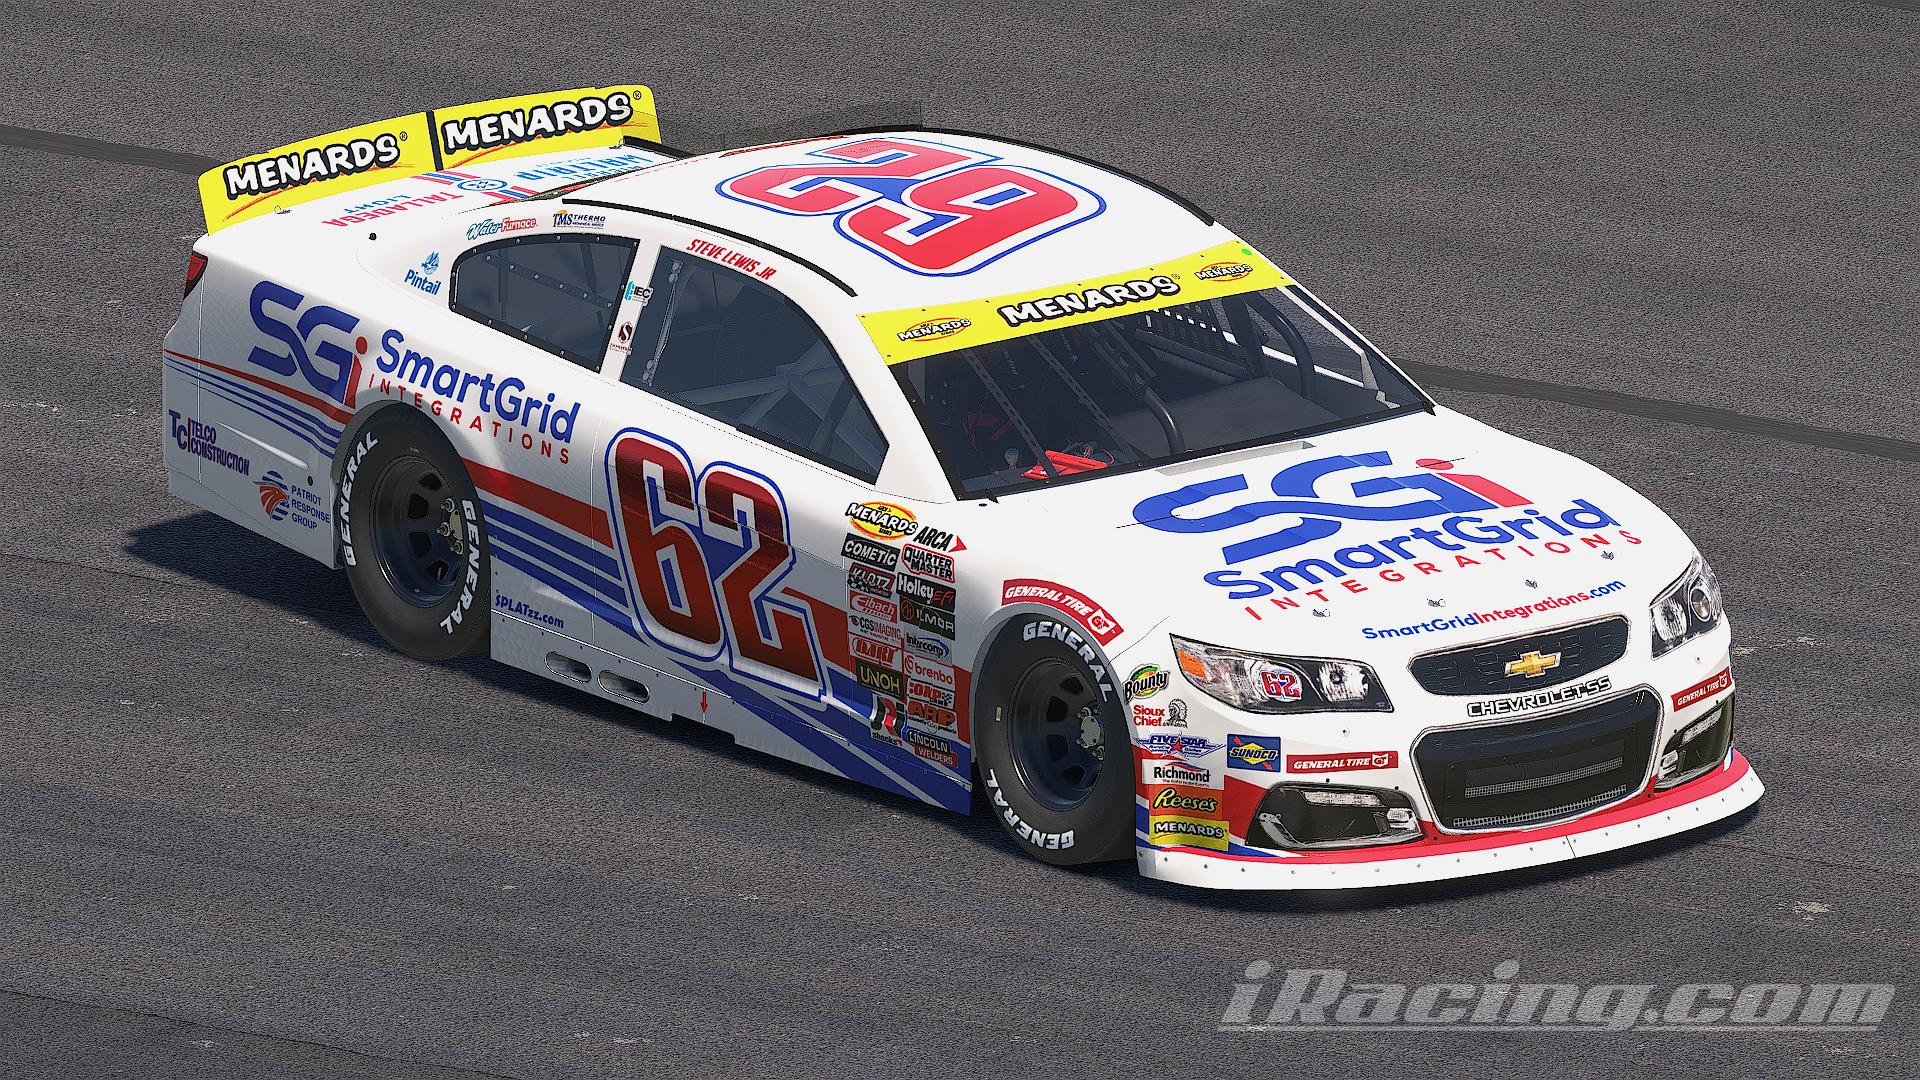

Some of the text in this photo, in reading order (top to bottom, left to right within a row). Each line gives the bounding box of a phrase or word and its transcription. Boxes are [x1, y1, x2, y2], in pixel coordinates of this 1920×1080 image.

[444, 93, 634, 155] MENARDS
[222, 136, 401, 199] MENARDS
[321, 192, 464, 227] TALLADEGA
[553, 213, 573, 228] TMS
[574, 214, 606, 222] THERMO
[686, 239, 777, 280] STEVE LEWIS JR
[1193, 263, 1253, 280] MENARDS
[404, 269, 441, 297] Pintail
[633, 286, 650, 298] IEC
[999, 275, 1181, 327] MENARDS
[897, 318, 971, 342] MENARDS
[376, 329, 581, 444] SmartGrid
[191, 419, 217, 444] TELCO
[369, 373, 570, 466] INTEGRATIONS
[191, 437, 250, 476] CONSTRUCTION
[291, 485, 322, 506] PATRIOT
[340, 431, 379, 567] GENERAL
[291, 499, 332, 524] RESPONSE
[291, 512, 318, 530] GROUP
[845, 502, 918, 535] MENARDS
[913, 526, 954, 551] ARCA
[1203, 499, 1623, 600] SmartGrid
[608, 430, 824, 696] 62
[845, 540, 896, 566] COMETIC
[904, 546, 952, 569] QUARTER
[440, 499, 480, 635] GENERAL
[911, 559, 953, 580] MASTER
[1244, 529, 1644, 621] INTEGRATIONS
[898, 574, 934, 604] Holley
[1005, 586, 1093, 616] GENERAL TIRE
[916, 608, 954, 633] ILMOR
[1362, 578, 1626, 641] SmartGridIntegrations.com
[1023, 621, 1112, 703] GENERAL
[860, 666, 900, 694] UNOH
[1123, 671, 1169, 705] Bounty
[1261, 671, 1300, 698] 62
[1467, 675, 1612, 717] CHEVROLET SS
[1677, 687, 1707, 706] GENERAL
[1133, 705, 1165, 716] Sioux
[1133, 716, 1163, 727] Chief
[908, 731, 949, 753] LINCOLN
[919, 746, 953, 764] WELDERS
[1230, 747, 1277, 760] SUNOCO
[1153, 766, 1210, 782] Richmond
[1294, 758, 1371, 769] GENERAL TIRE
[985, 769, 1075, 850] GENERAL
[1154, 821, 1224, 839] MENARDS
